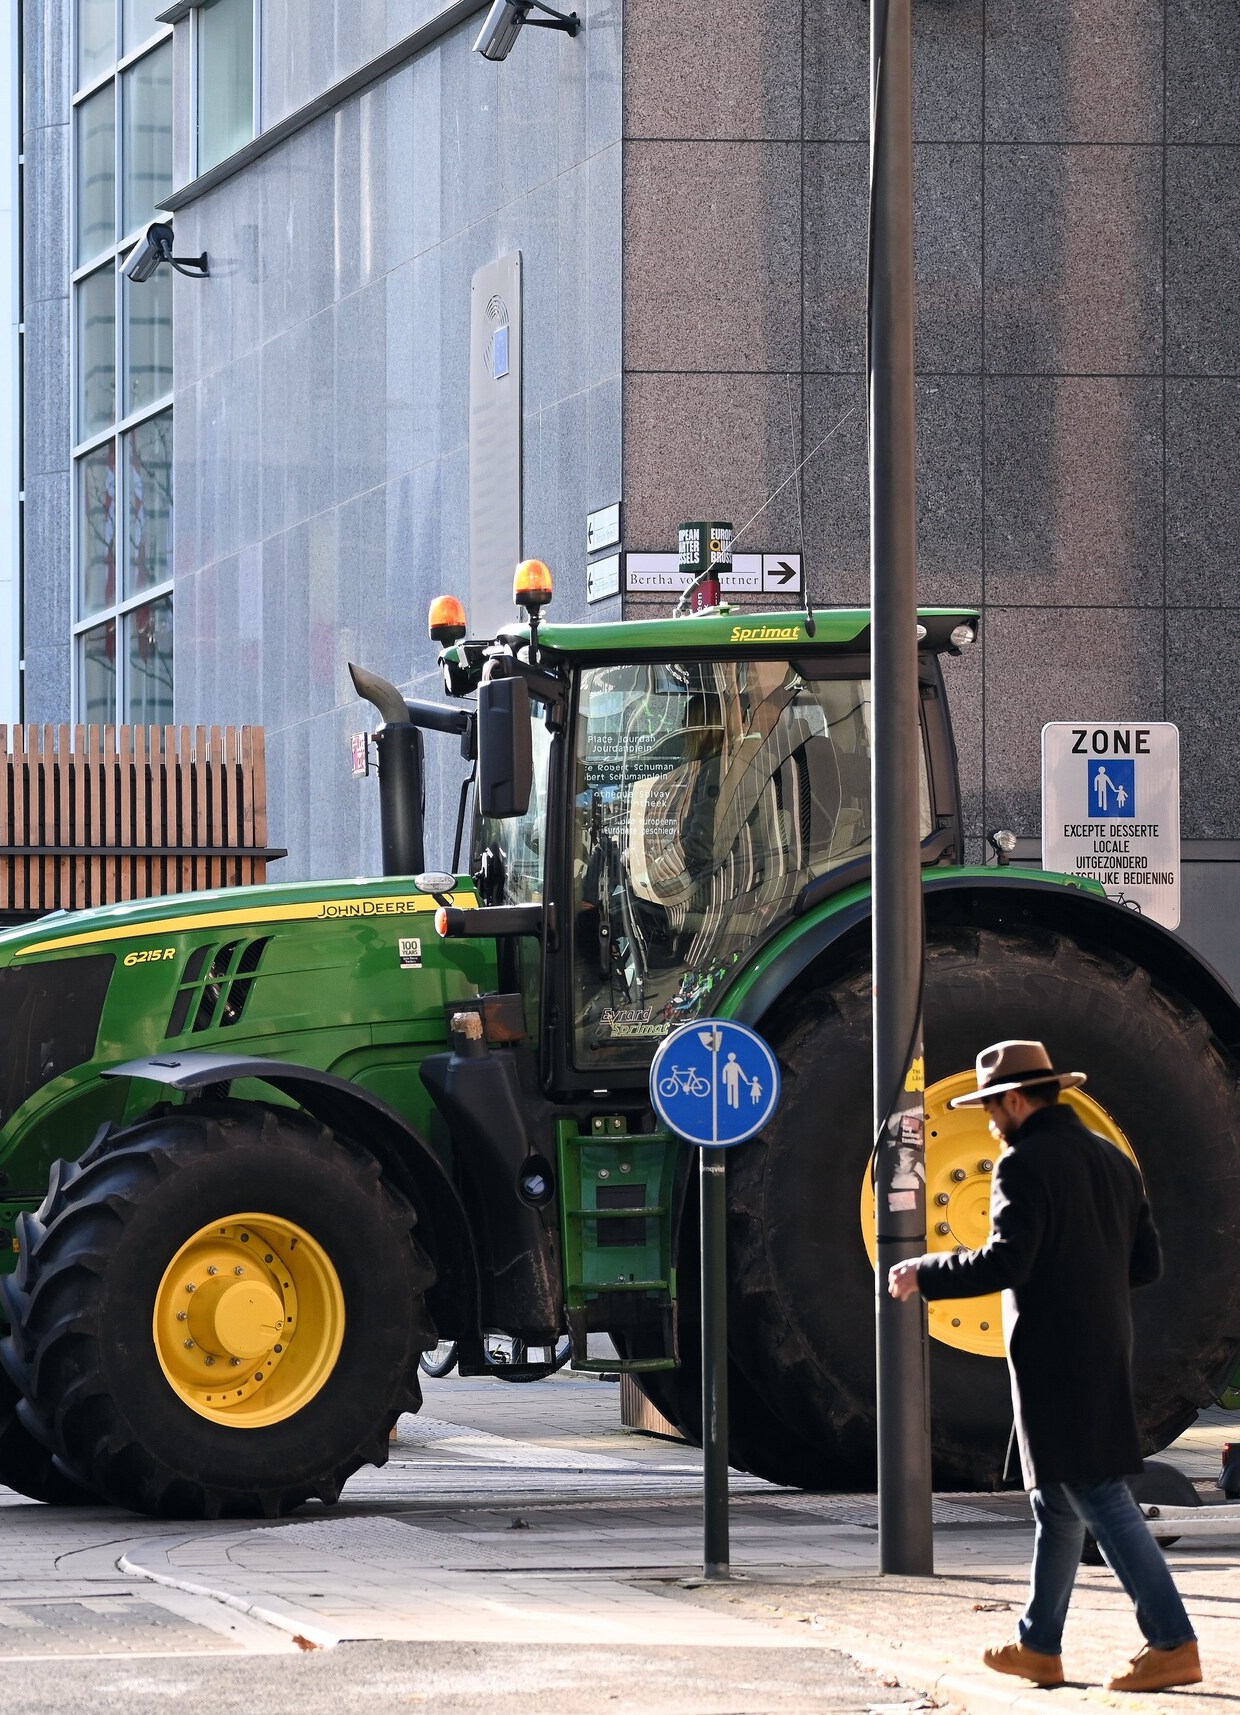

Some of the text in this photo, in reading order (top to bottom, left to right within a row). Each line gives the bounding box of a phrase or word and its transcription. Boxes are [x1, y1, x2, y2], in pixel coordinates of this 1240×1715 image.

[630, 573, 759, 585] Bertha vo uttner
[730, 625, 800, 642] Sprimat
[587, 735, 656, 744] Place Jourdan
[1072, 729, 1150, 754] ZONE
[592, 744, 652, 753] Jourdanplein
[634, 763, 674, 771] Schuman
[586, 773, 605, 781] bert
[1064, 824, 1159, 837] EXCEPTE DESSERTE
[1093, 840, 1130, 853] LOCALE
[1076, 856, 1148, 869] UITGEZONDERD
[1123, 872, 1174, 885] BEDIENING
[317, 901, 416, 917] JOHN DEERE
[401, 941, 418, 949] 100
